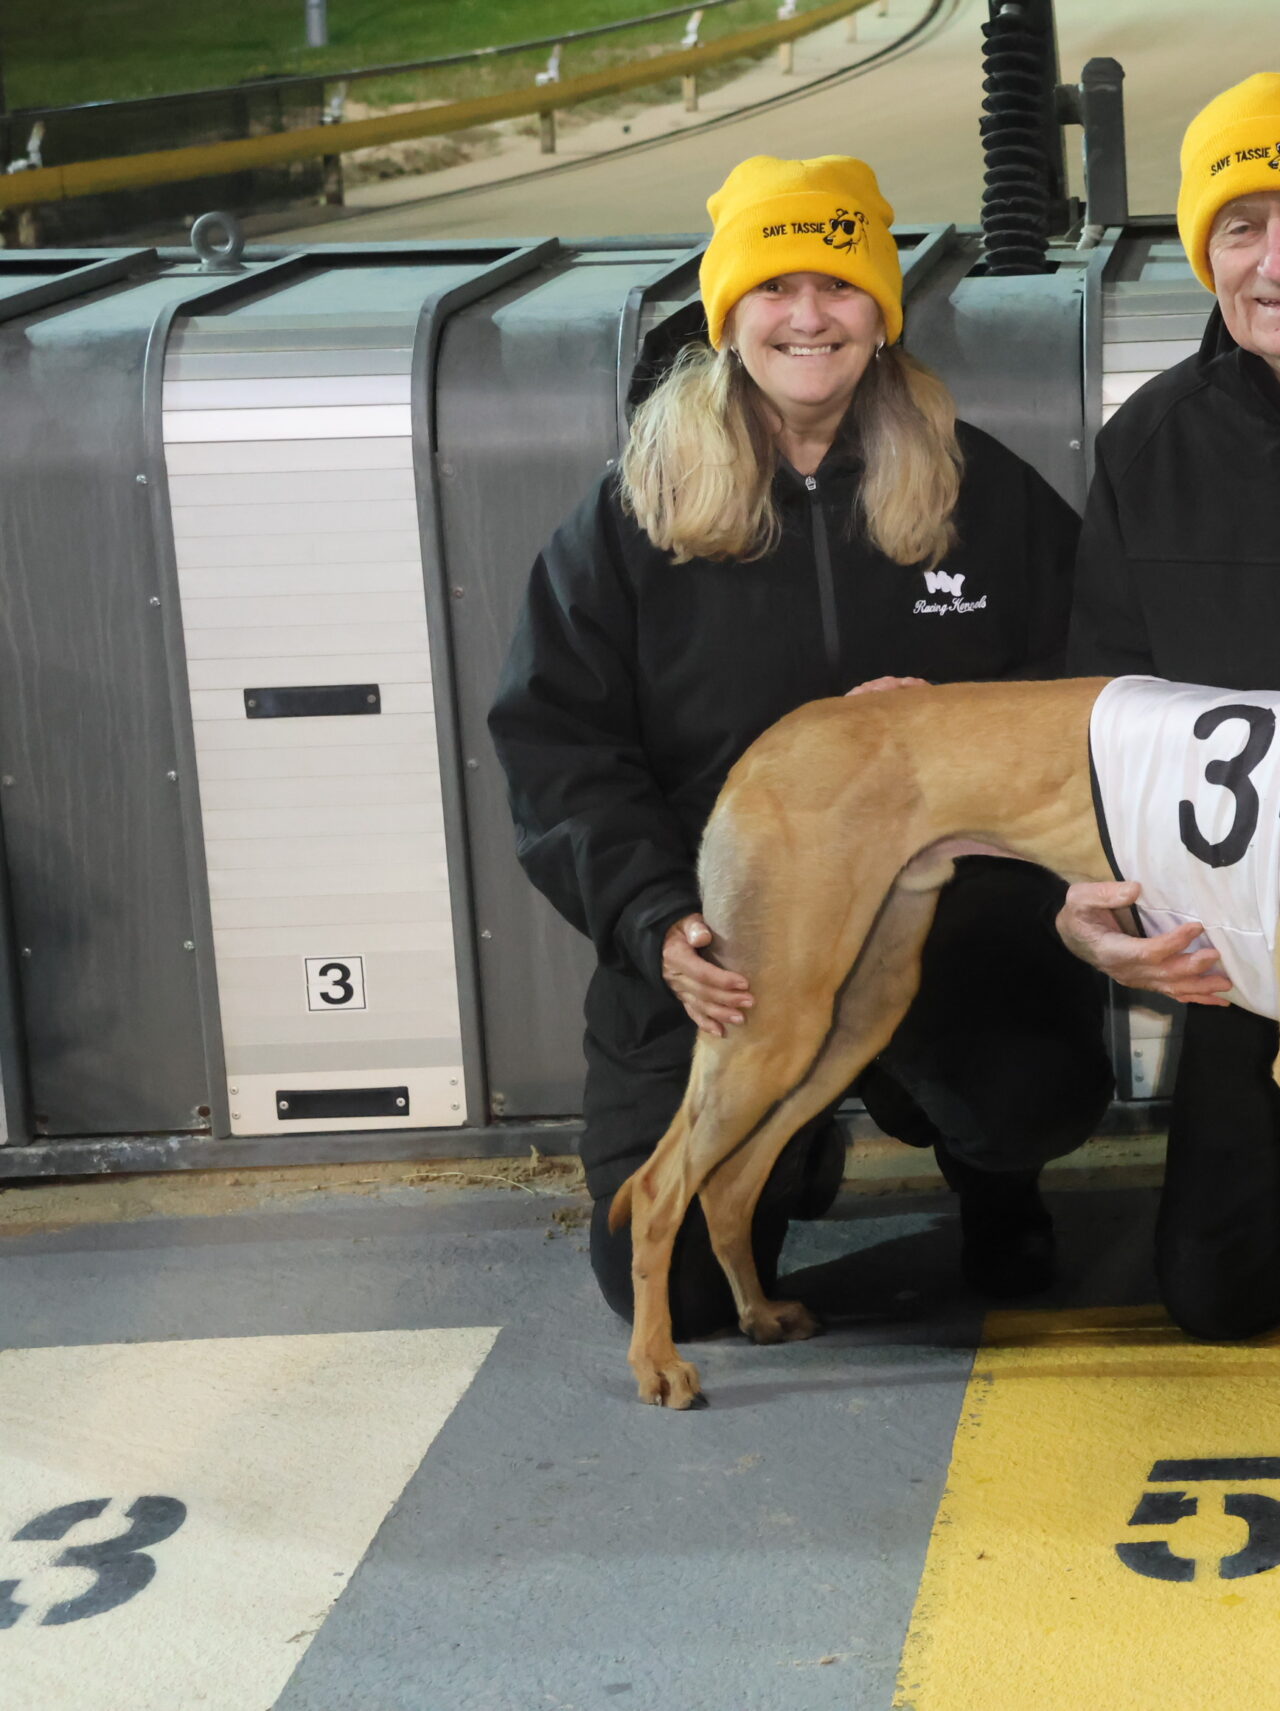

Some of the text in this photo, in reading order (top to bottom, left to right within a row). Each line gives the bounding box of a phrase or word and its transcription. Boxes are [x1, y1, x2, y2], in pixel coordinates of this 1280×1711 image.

[1211, 147, 1271, 176] SAVE TASSIE
[762, 222, 826, 238] SAVE TASSIE
[912, 595, 987, 616] Racing Kennels
[1178, 703, 1277, 869] 3
[318, 962, 355, 1006] 3
[0, 1494, 188, 1630] 3
